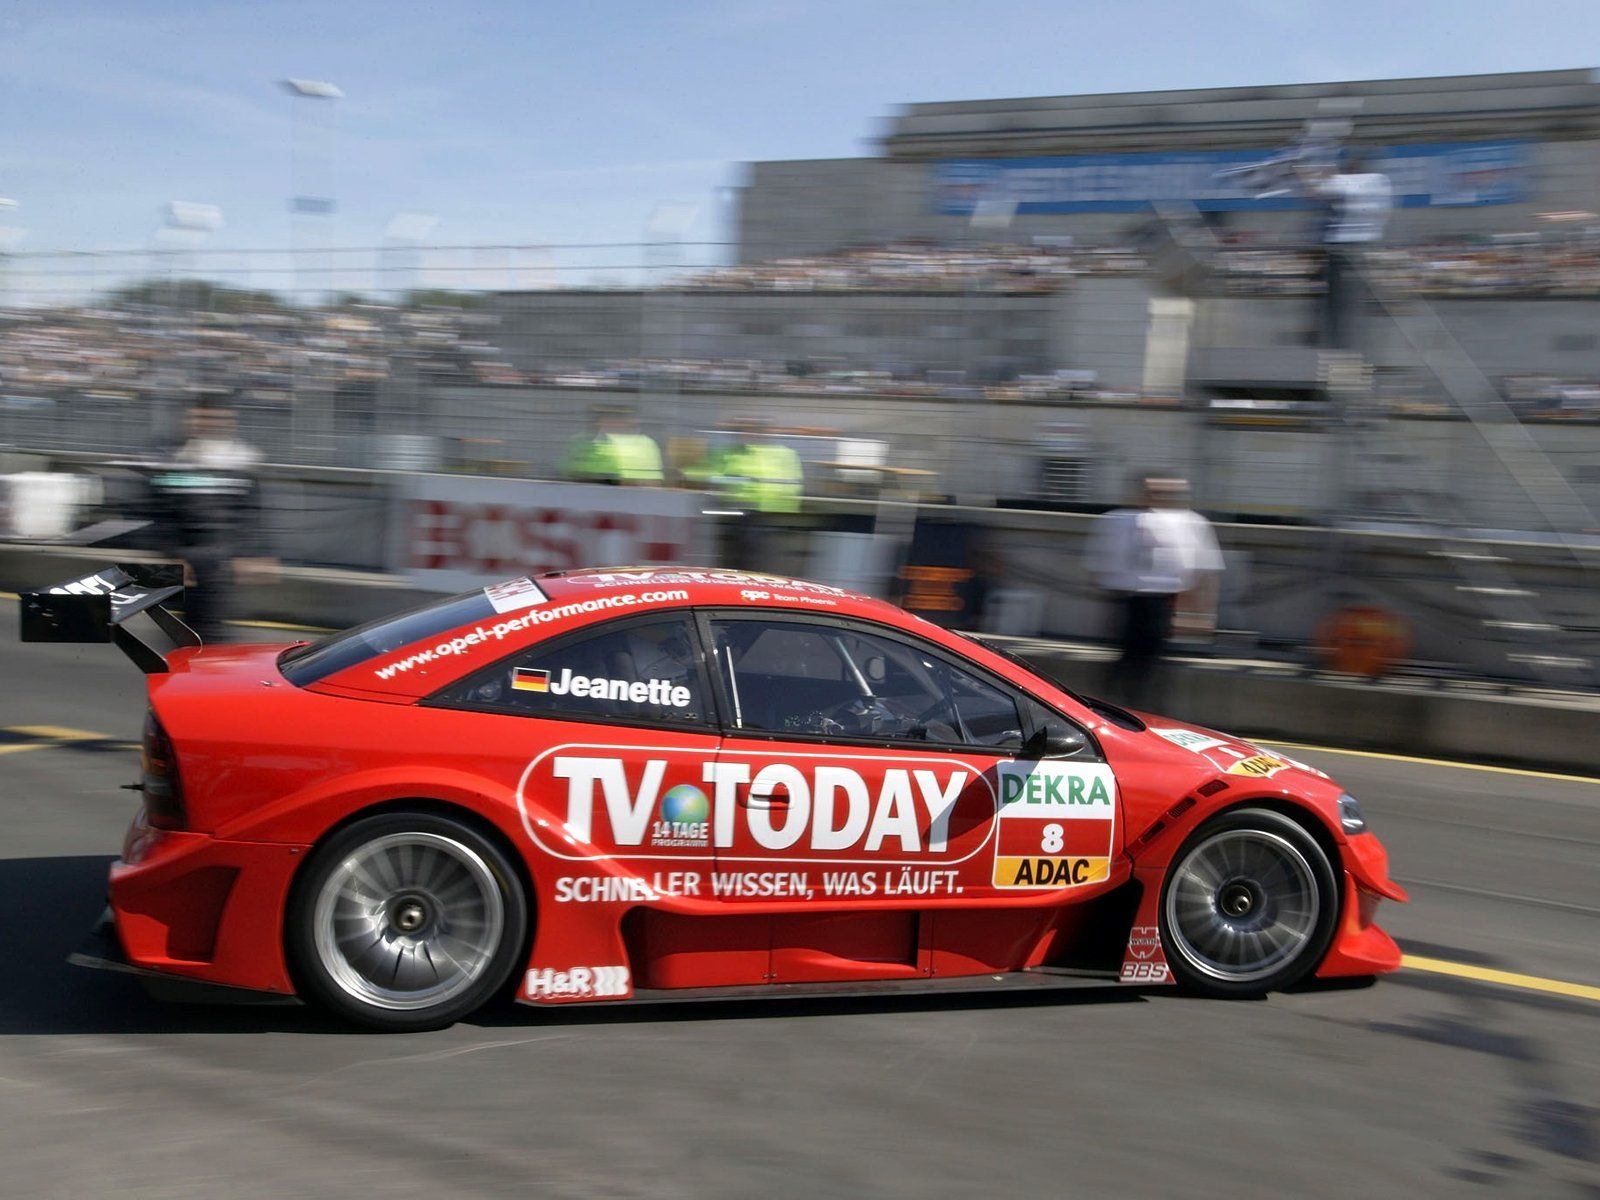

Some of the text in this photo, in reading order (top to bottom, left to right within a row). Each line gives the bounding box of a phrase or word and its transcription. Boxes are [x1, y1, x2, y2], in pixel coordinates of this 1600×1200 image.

[773, 593, 799, 602] Team
[799, 596, 837, 606] Phoenix
[374, 588, 689, 680] www.opel-performance.com
[550, 668, 691, 708] Jeanette
[552, 756, 970, 853] TV TODAY
[1002, 772, 1112, 806] DEKRA
[652, 821, 710, 839] 14 TAGE
[1040, 823, 1065, 853] 8
[554, 866, 965, 902] SCHNELLER WISSEN, WAS LÄUFT.
[1013, 859, 1090, 886] ADAC
[525, 966, 592, 997] H&R
[1119, 961, 1169, 982] BBS
